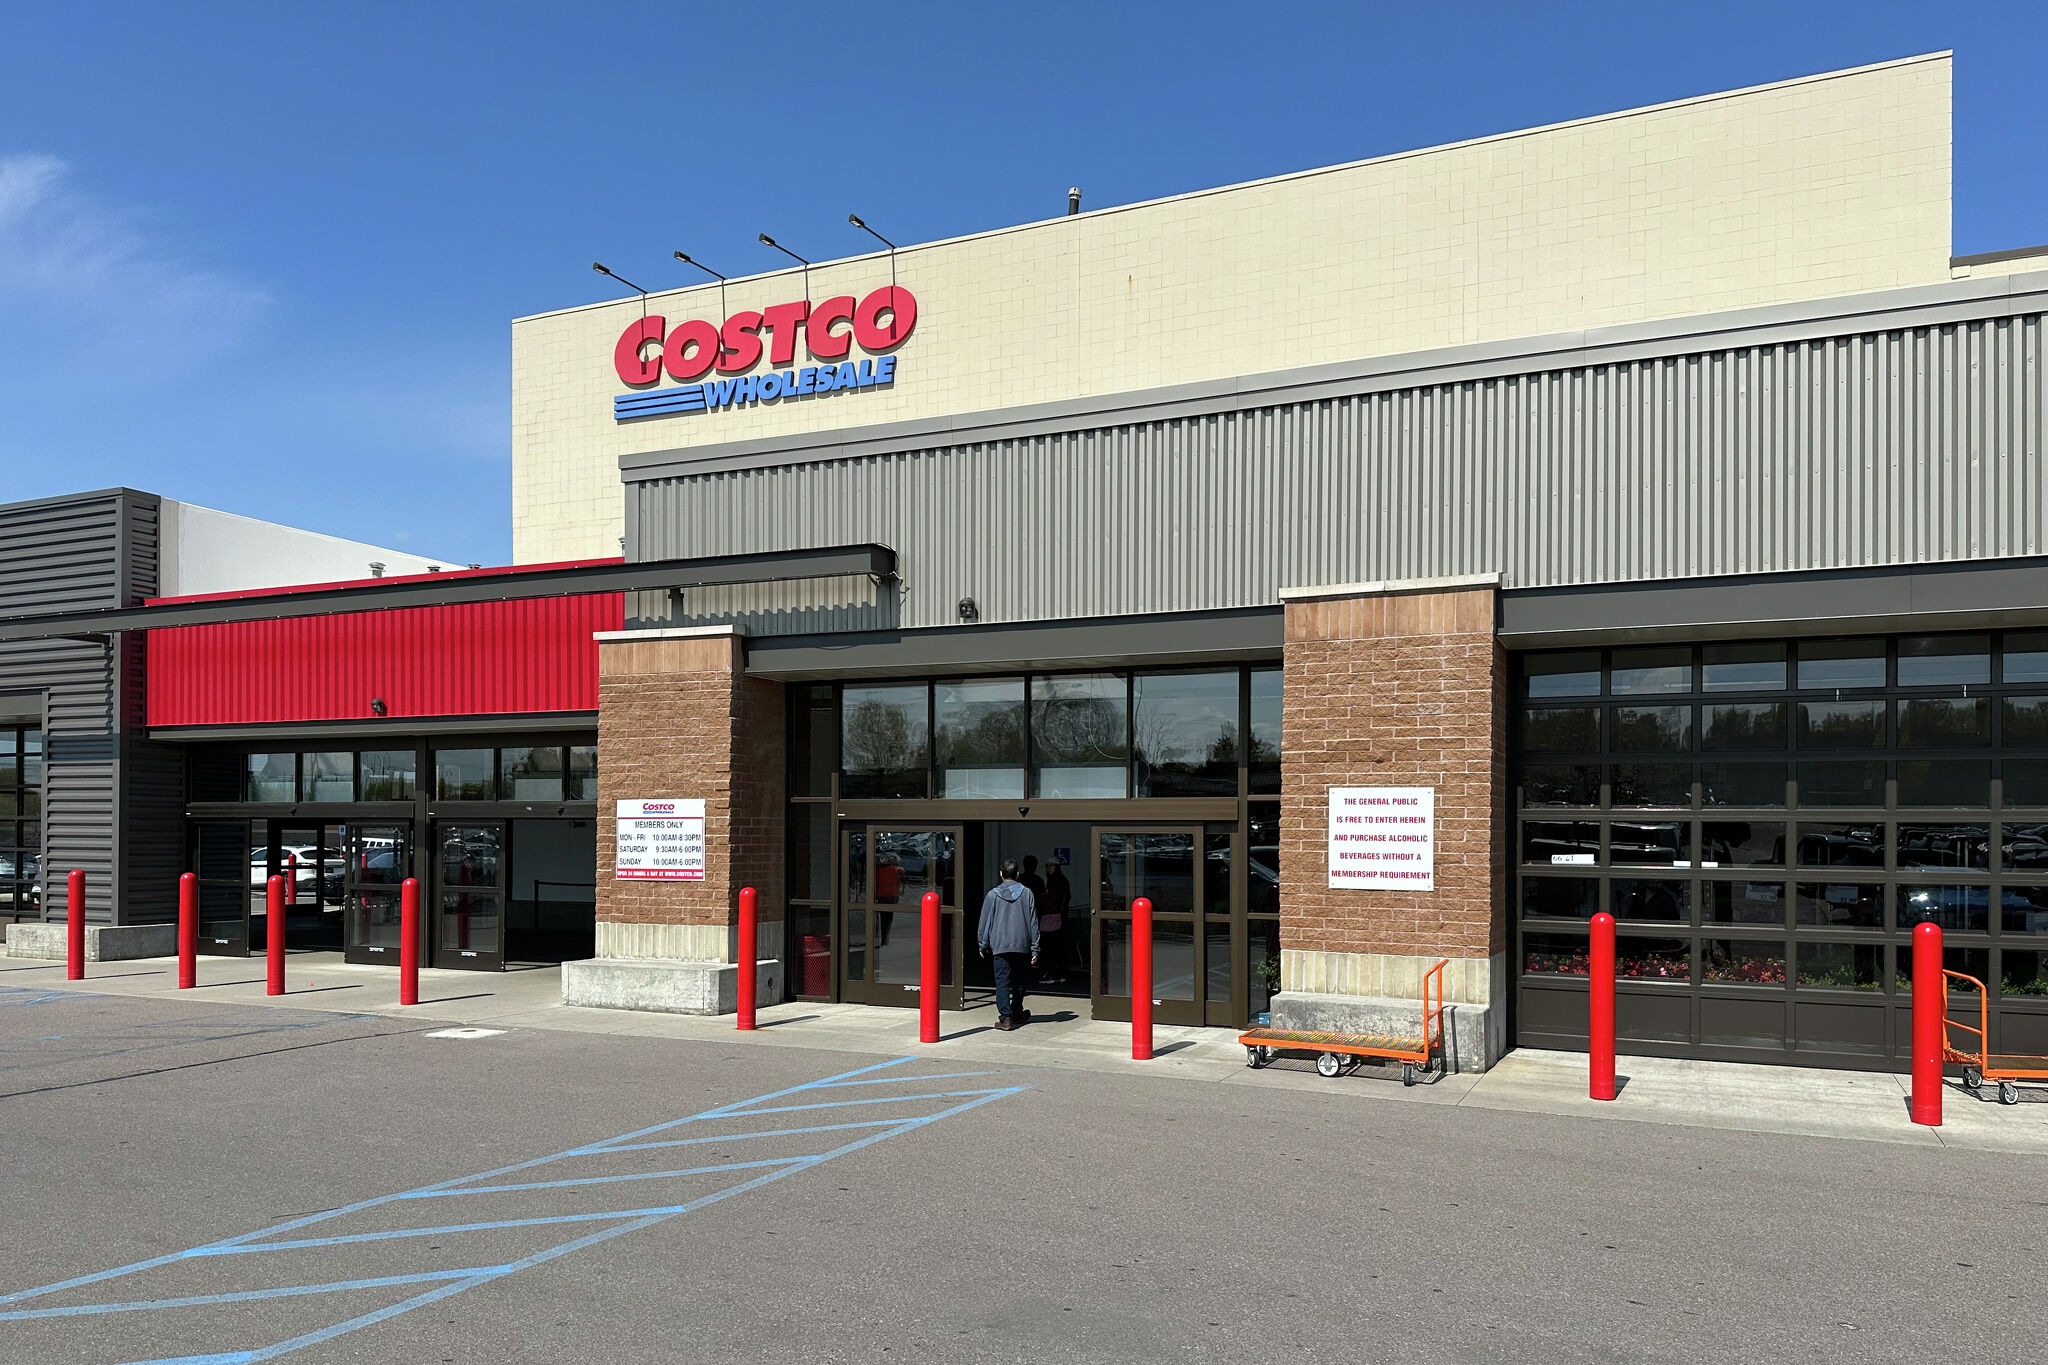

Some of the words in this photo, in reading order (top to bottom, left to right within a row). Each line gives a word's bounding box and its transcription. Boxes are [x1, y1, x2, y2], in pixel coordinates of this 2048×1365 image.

[614, 285, 918, 385] COSTCO
[702, 355, 898, 408] WHOLESALE
[1344, 798, 1357, 806] THE
[1358, 798, 1390, 806] GENERAL
[1392, 798, 1418, 806] PUBLIC
[1336, 816, 1343, 824] IS
[1345, 816, 1362, 824] FREE
[1364, 816, 1374, 824] TO
[1375, 816, 1398, 824] ENTER
[1399, 816, 1426, 824] HEREIN
[635, 821, 665, 829] MEMBERS
[666, 821, 684, 829] ONLY
[619, 833, 633, 841] MON
[1334, 834, 1348, 842] AND
[1349, 834, 1387, 842] PURCHASE
[1388, 834, 1428, 843] ALCOHOLIC
[619, 845, 648, 853] SATURDAY
[1339, 852, 1380, 861] BEVERAGES
[1382, 853, 1415, 861] WITHOUT
[619, 858, 642, 866] SUNDAY
[1331, 870, 1378, 878] MEMBERSHIP
[1379, 871, 1431, 880] REQUIREMENT
